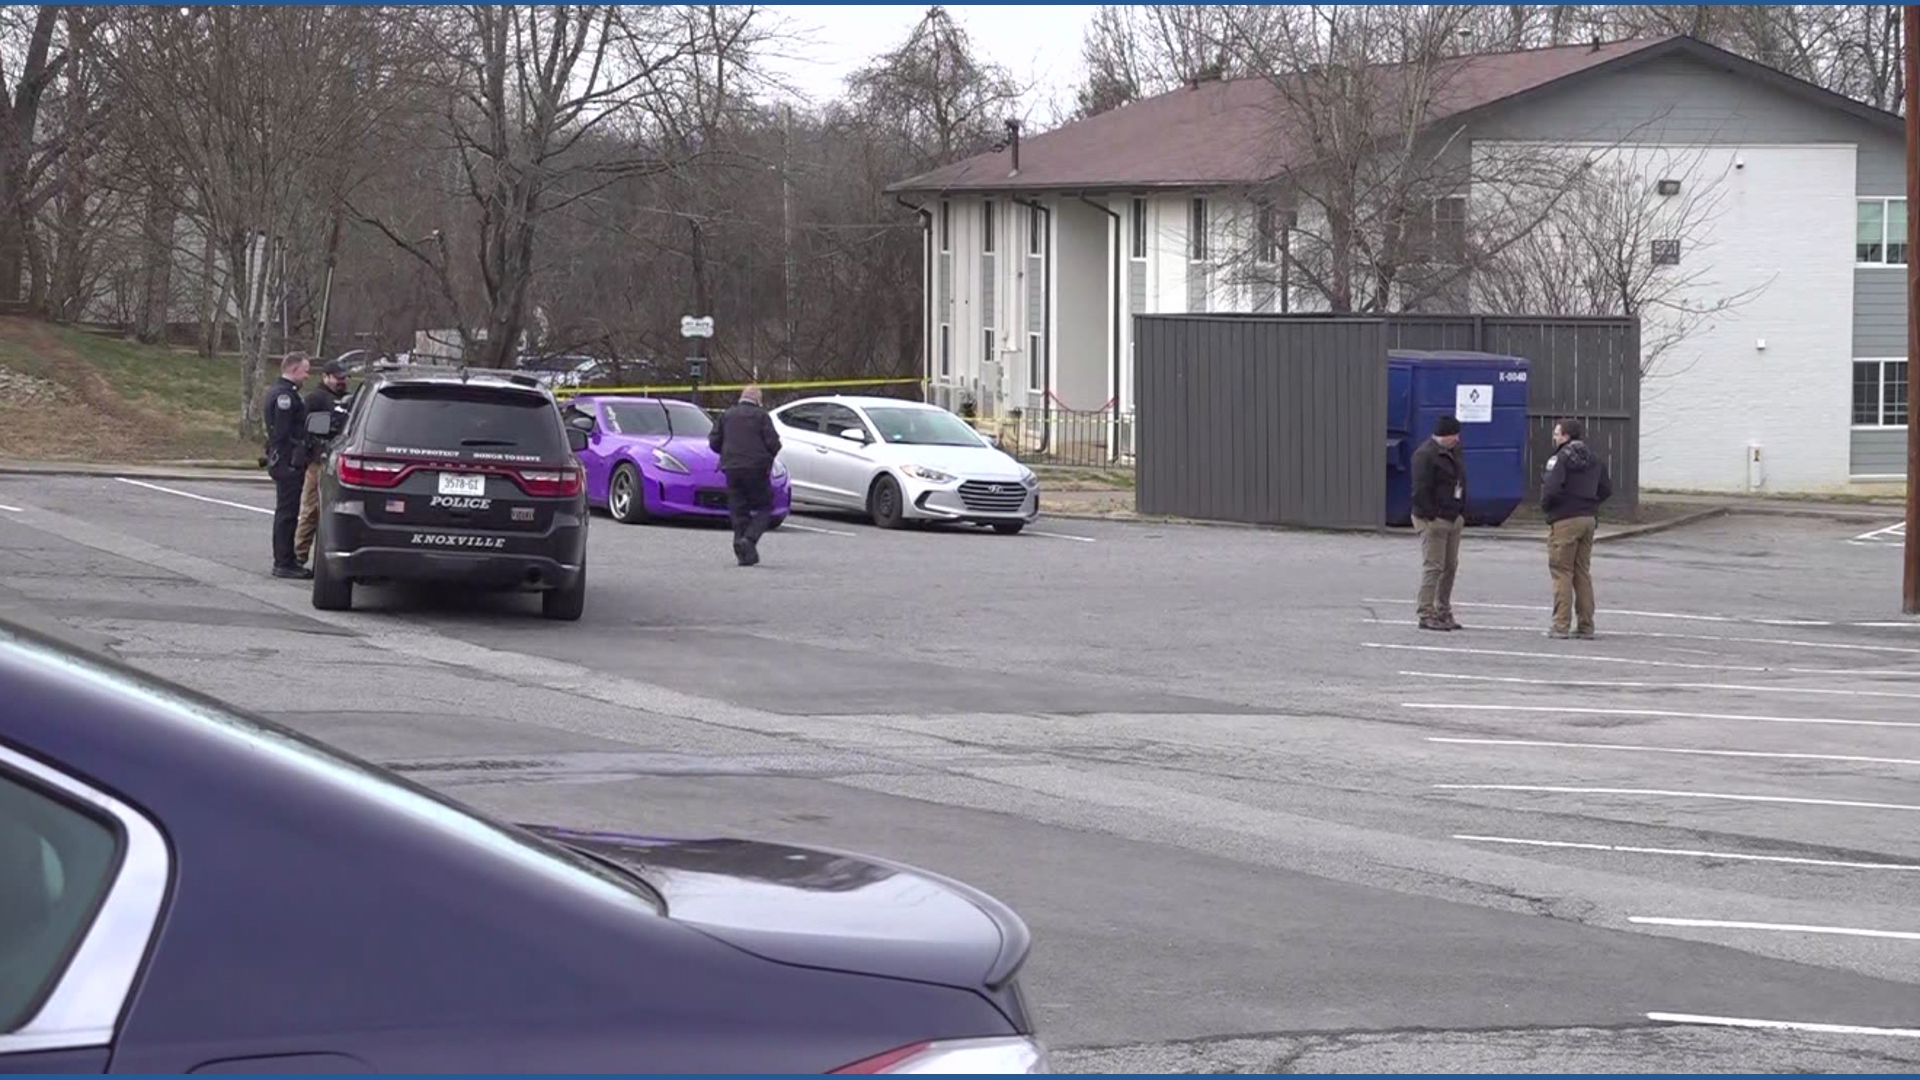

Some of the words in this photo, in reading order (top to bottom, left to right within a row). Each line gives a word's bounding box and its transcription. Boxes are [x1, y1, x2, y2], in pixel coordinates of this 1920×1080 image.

[421, 449, 460, 457] PROTECT
[430, 496, 491, 509] POLICE
[411, 534, 505, 547] KNOXVILLE
